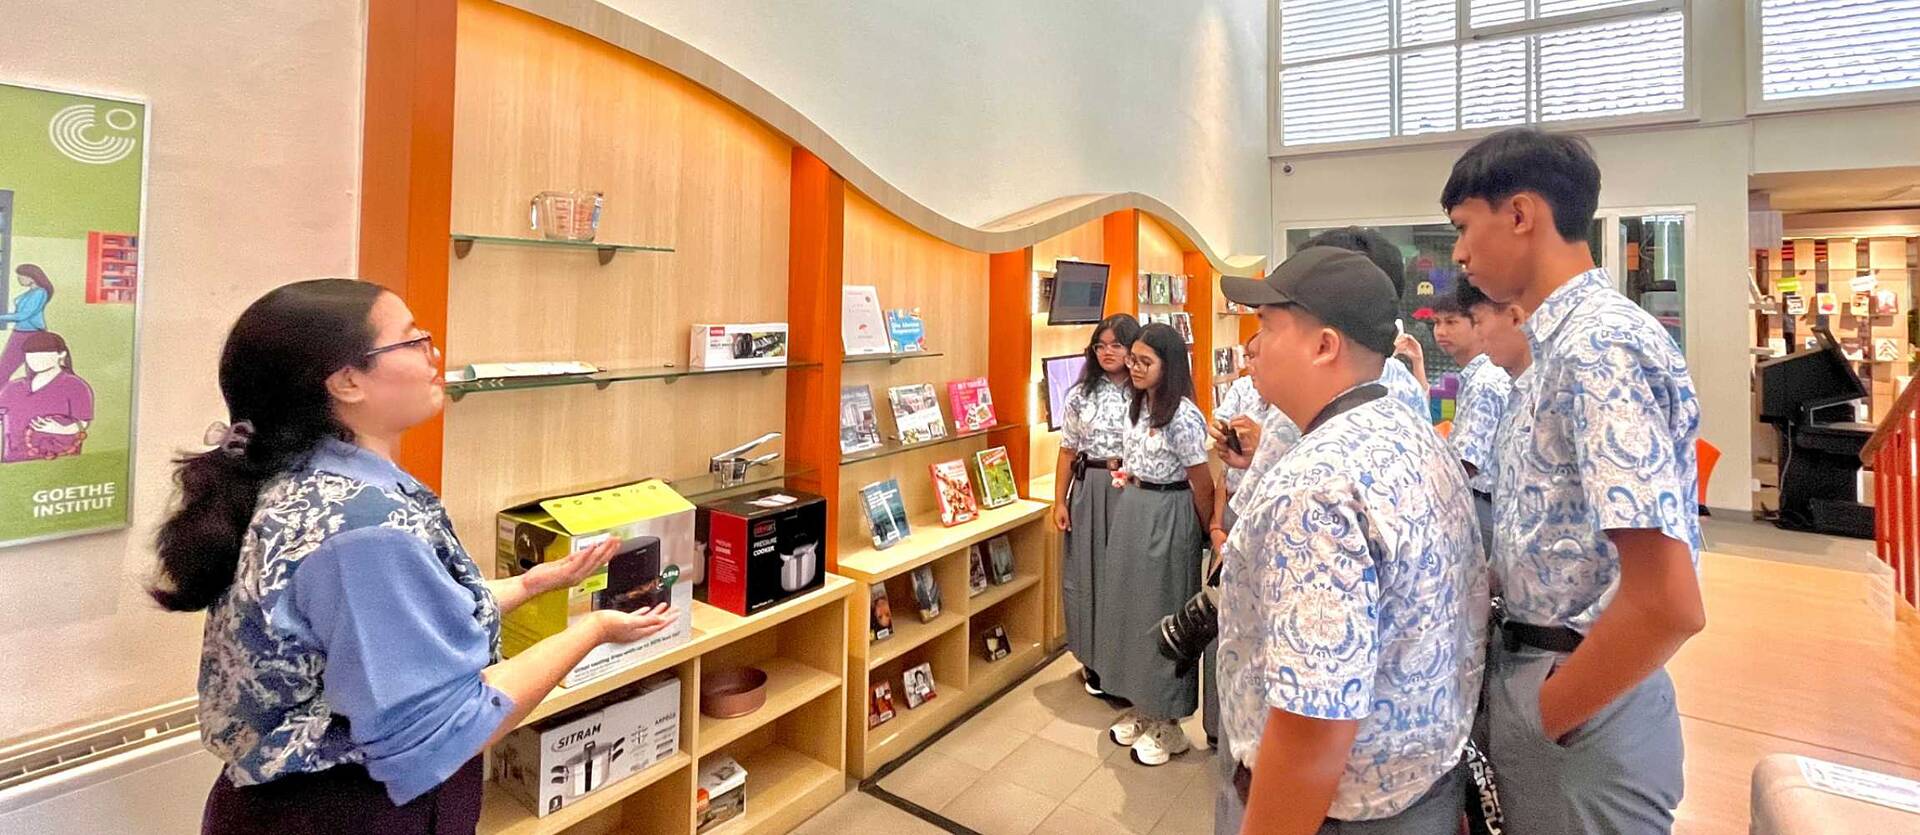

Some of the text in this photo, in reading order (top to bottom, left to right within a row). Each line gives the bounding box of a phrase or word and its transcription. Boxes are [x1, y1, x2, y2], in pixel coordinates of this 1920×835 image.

[32, 481, 116, 503] GOETHE
[33, 496, 116, 518] INSTITUT
[753, 546, 775, 557] COOKER
[557, 723, 602, 750] SITRAM
